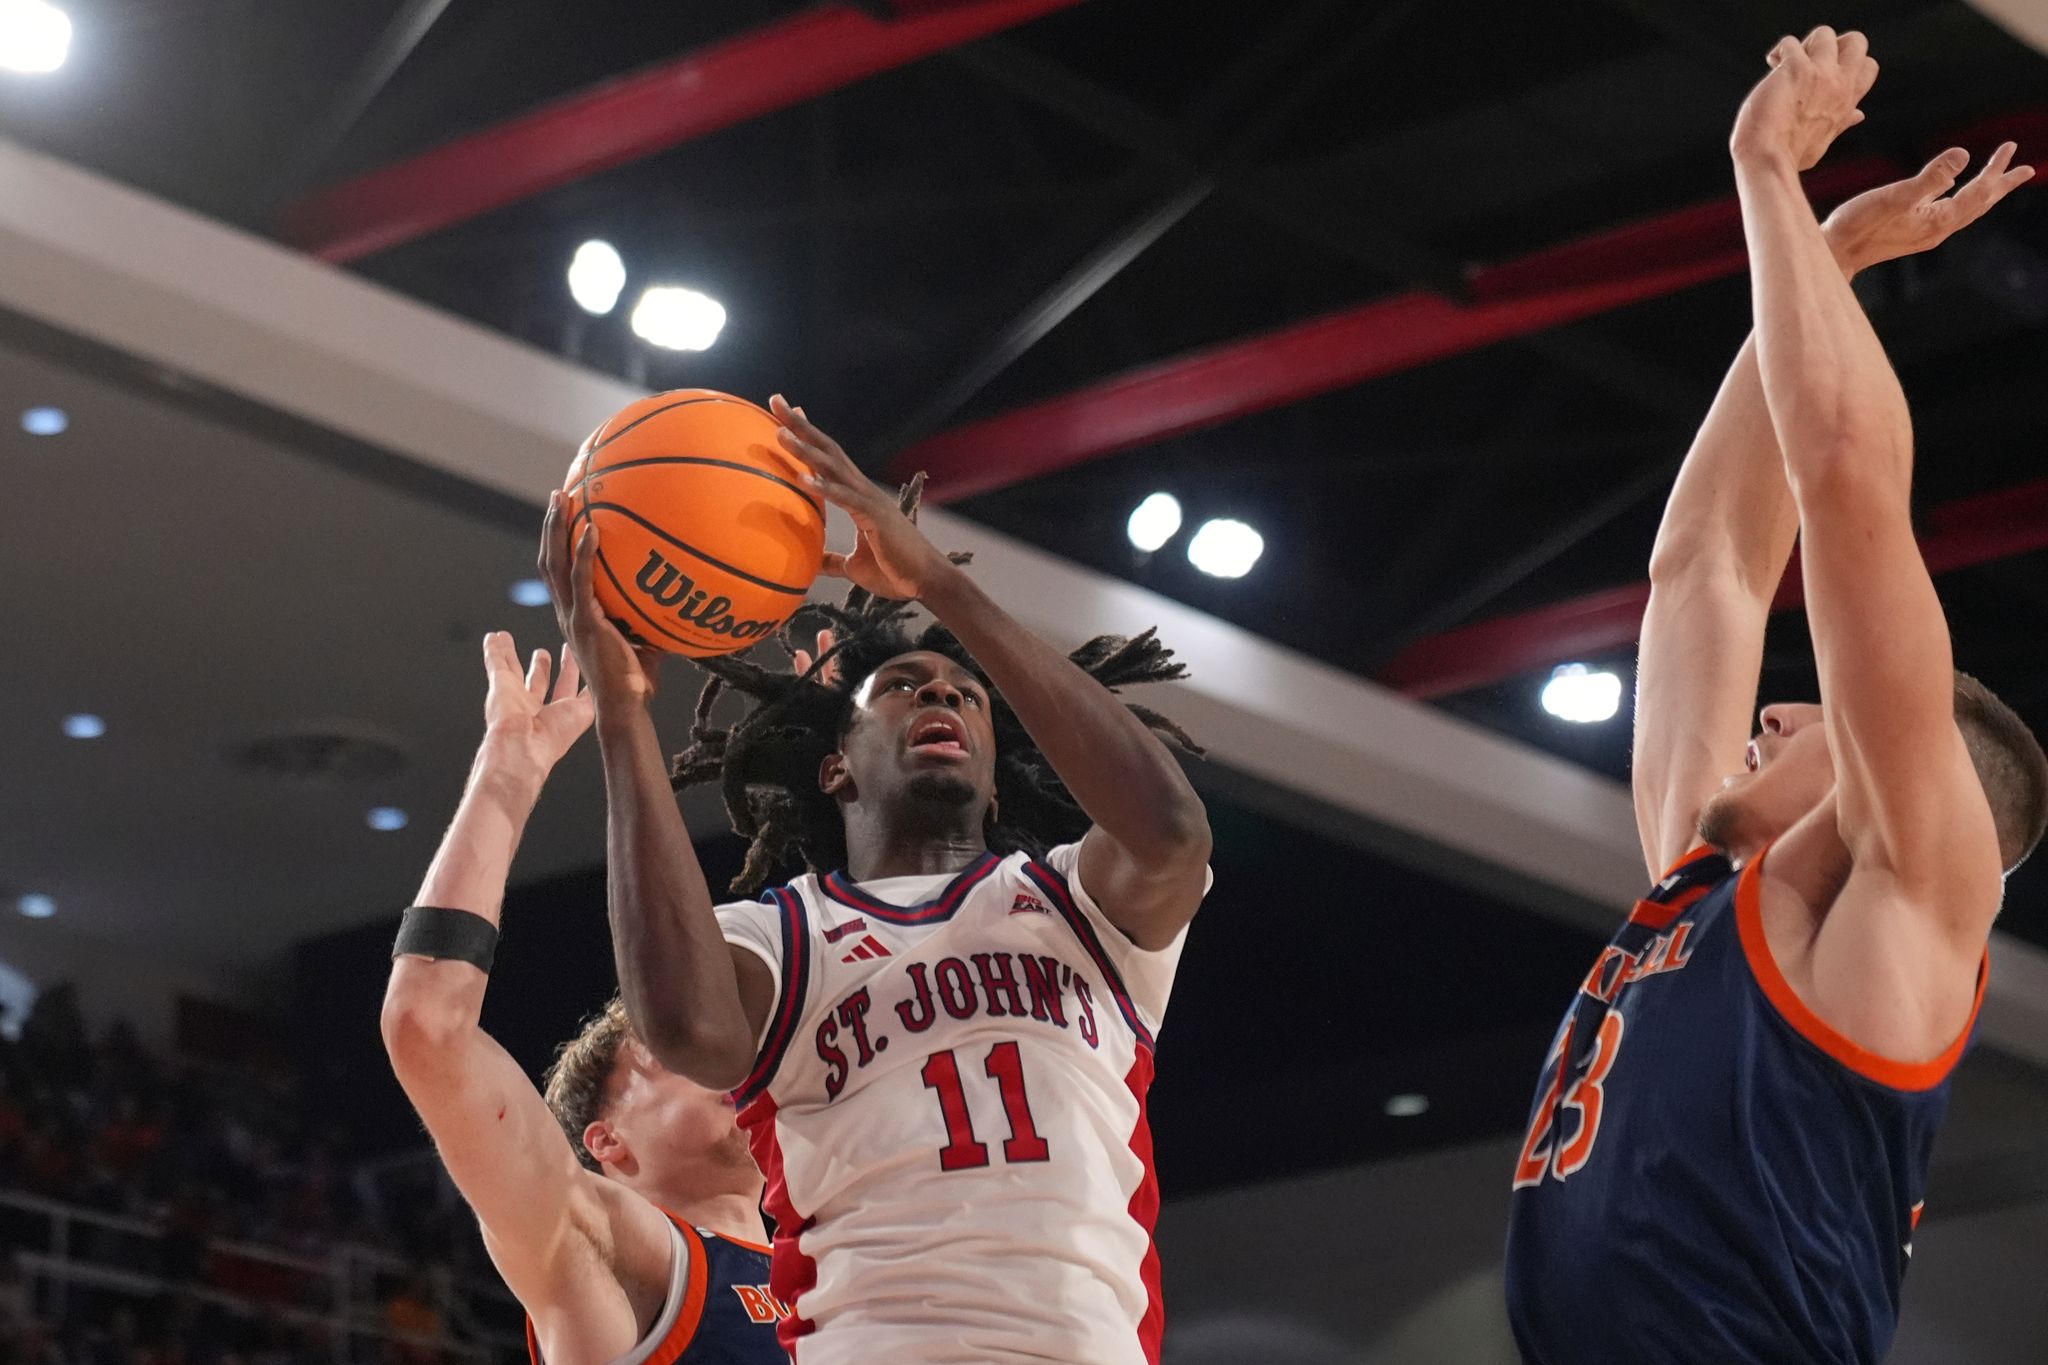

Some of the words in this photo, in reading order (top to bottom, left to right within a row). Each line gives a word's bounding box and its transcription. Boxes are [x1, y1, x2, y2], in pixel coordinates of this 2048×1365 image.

[636, 548, 779, 639] Wilson
[815, 985, 888, 1103] ST.
[895, 952, 1099, 1050] JOHN'S
[920, 1040, 1050, 1172] 11
